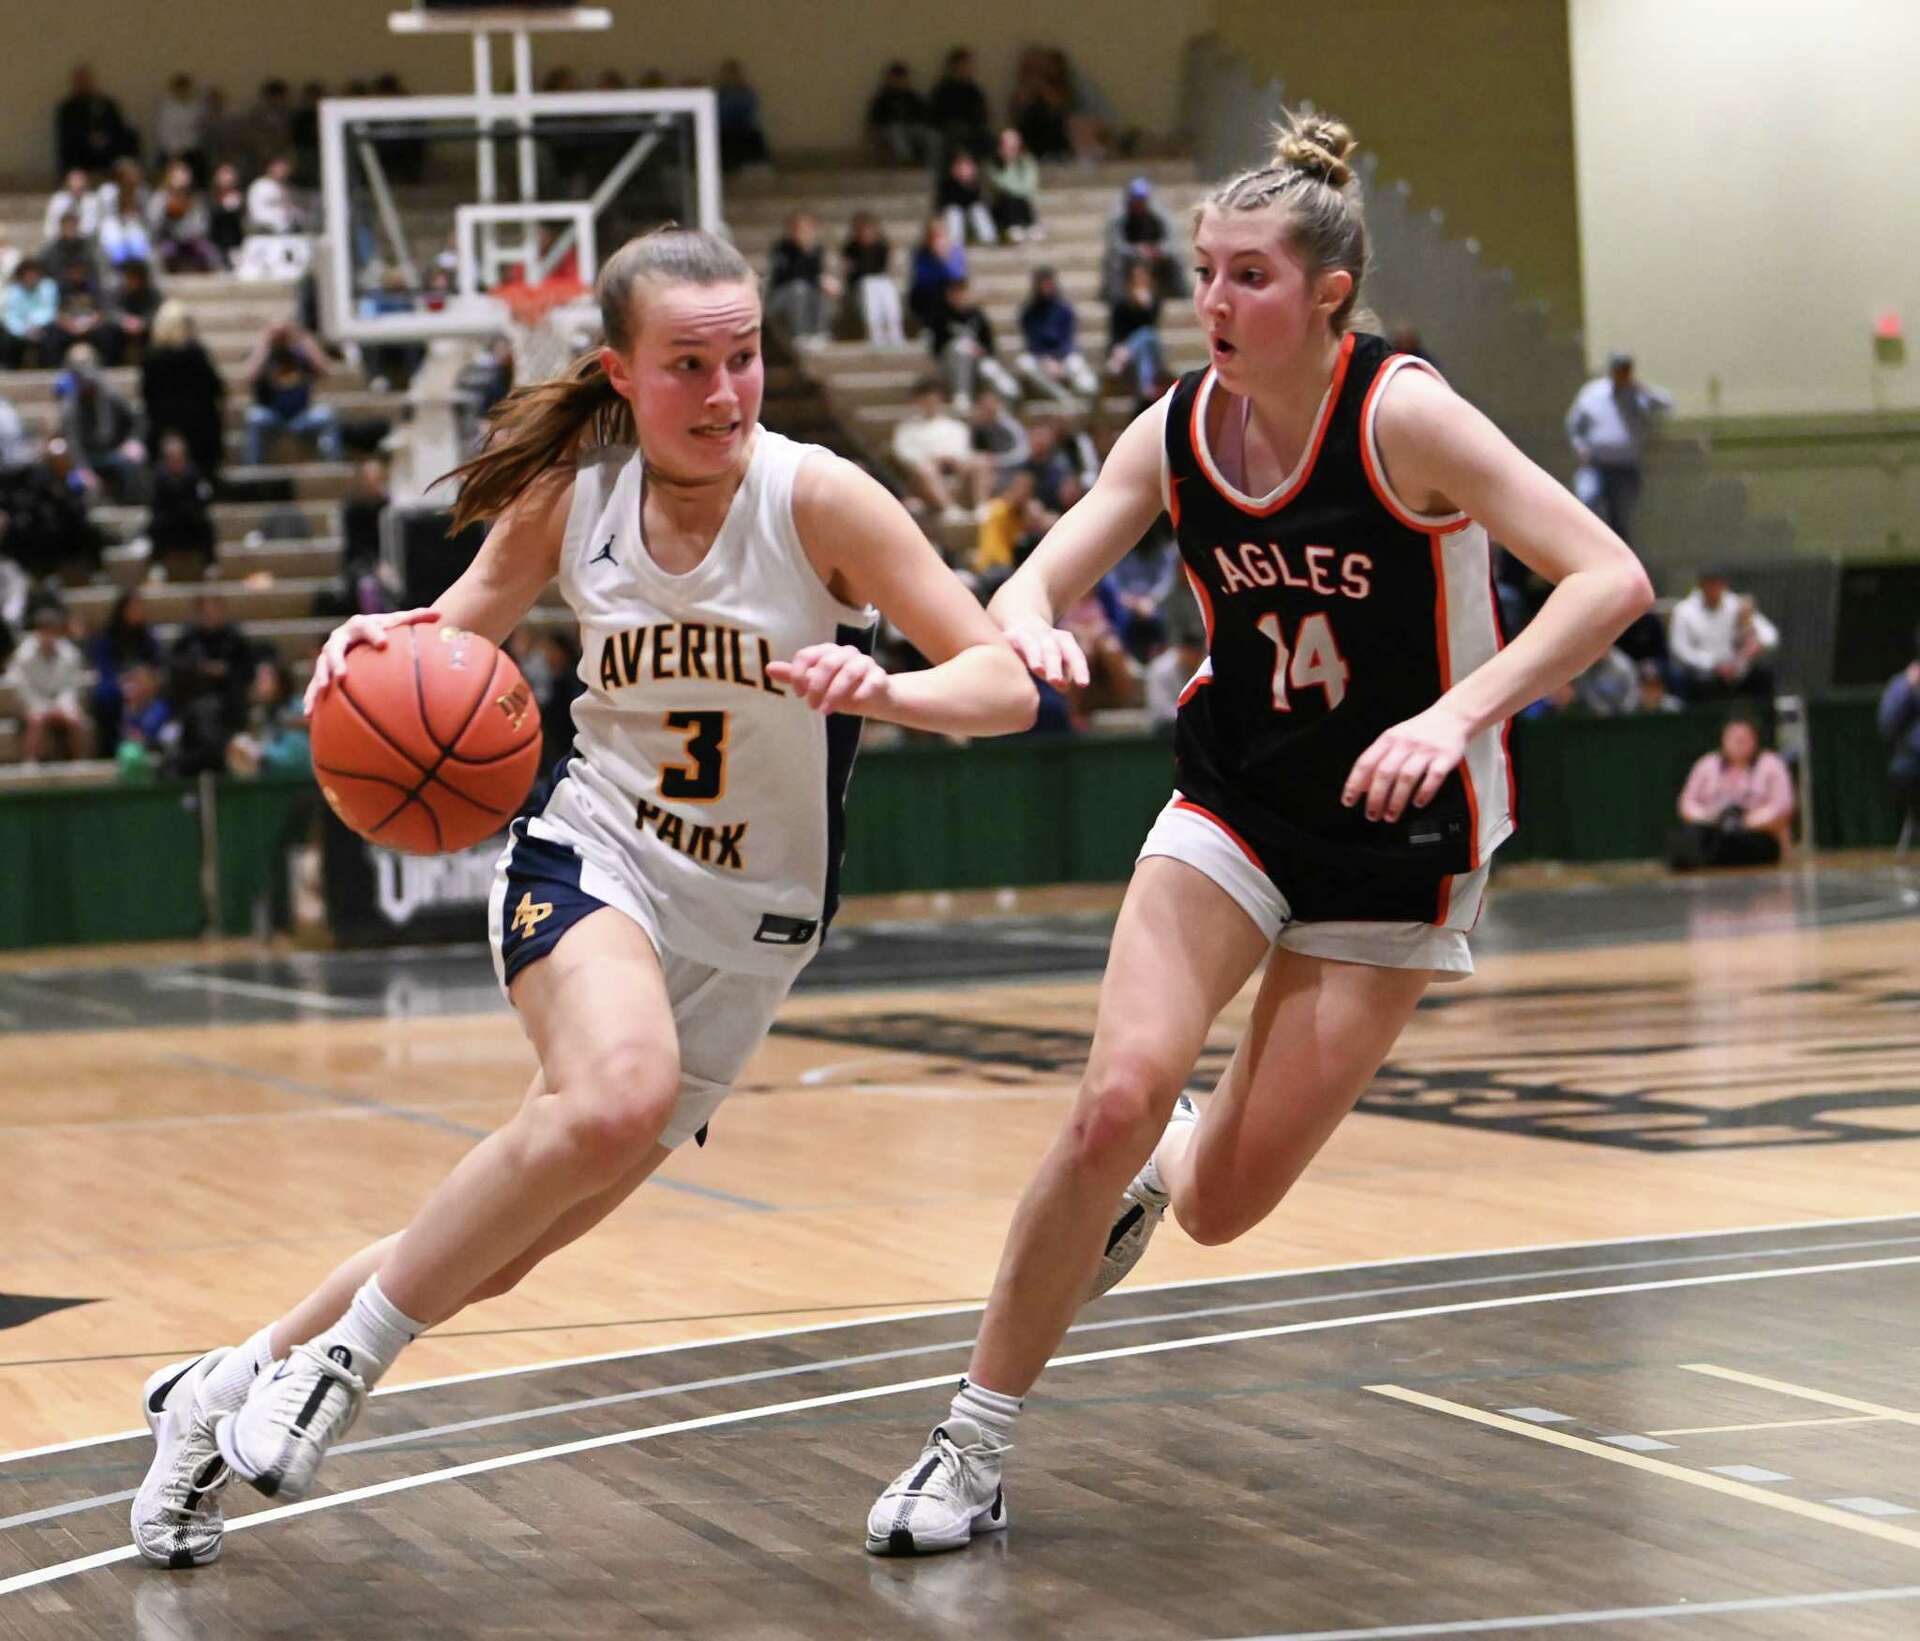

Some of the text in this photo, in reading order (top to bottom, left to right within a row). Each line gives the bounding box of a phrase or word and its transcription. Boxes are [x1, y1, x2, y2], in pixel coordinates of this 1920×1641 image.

[1213, 542, 1374, 600] AGLES
[600, 622, 786, 696] AVERILL
[1256, 611, 1351, 713] 14
[657, 708, 730, 804] 3
[511, 891, 553, 939] AP
